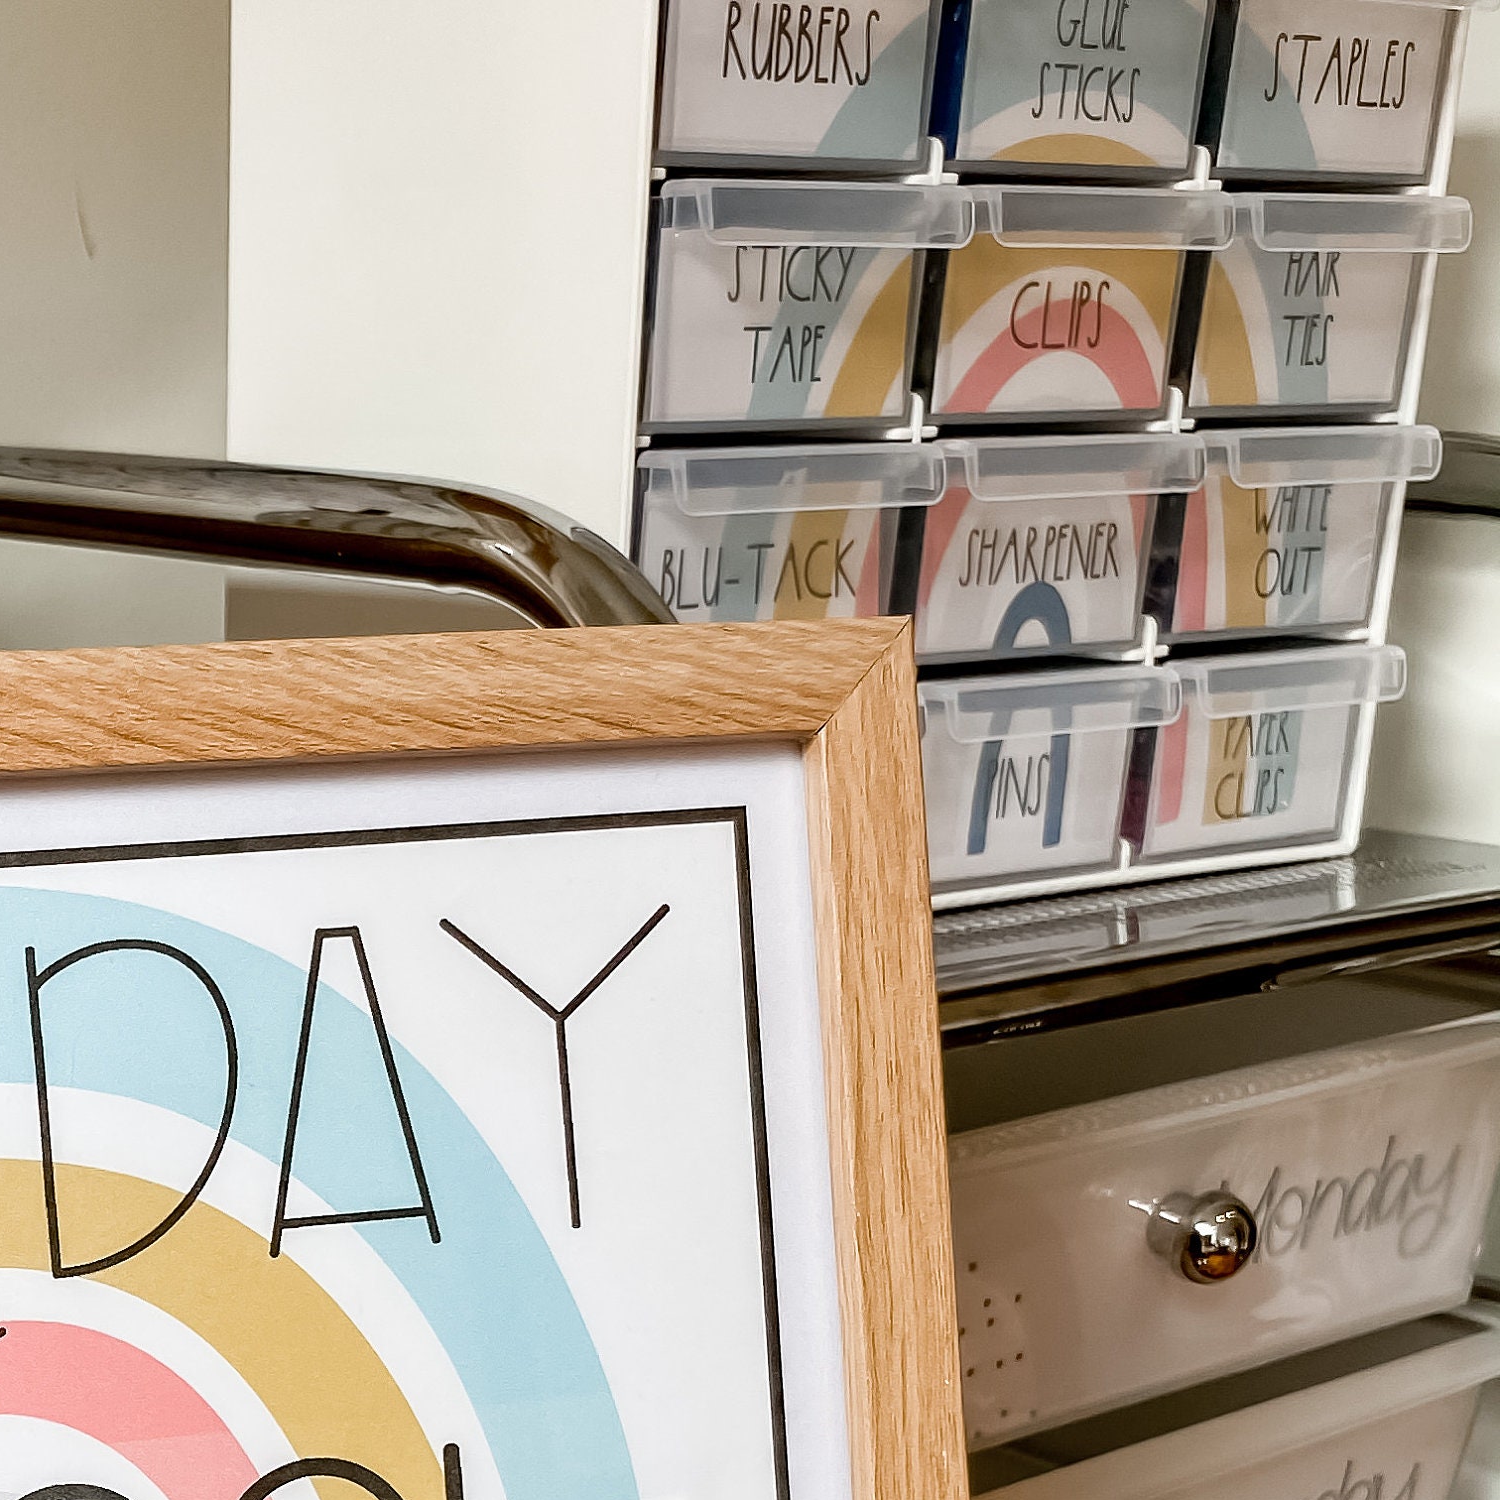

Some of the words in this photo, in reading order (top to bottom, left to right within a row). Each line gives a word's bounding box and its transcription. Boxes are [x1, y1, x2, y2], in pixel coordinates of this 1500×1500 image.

[721, 1, 881, 86] RUBBERS
[1056, 0, 1130, 51] GLUE
[1031, 62, 1141, 123] STICKS
[1263, 31, 1417, 110] STAPLES
[727, 245, 856, 303] STICKY
[1009, 280, 1112, 350] CLIPS
[1283, 314, 1334, 367] TIES
[743, 325, 826, 384] TAPE
[1254, 484, 1334, 534] WHITE
[660, 538, 857, 611] BLU-TACK
[958, 522, 1119, 587] SHARPENER
[1255, 546, 1322, 599] OUT
[1223, 711, 1290, 760] PAPER
[988, 754, 1050, 820] PINS
[1213, 767, 1286, 820] CLIPS
[24, 902, 671, 1280] DAY
